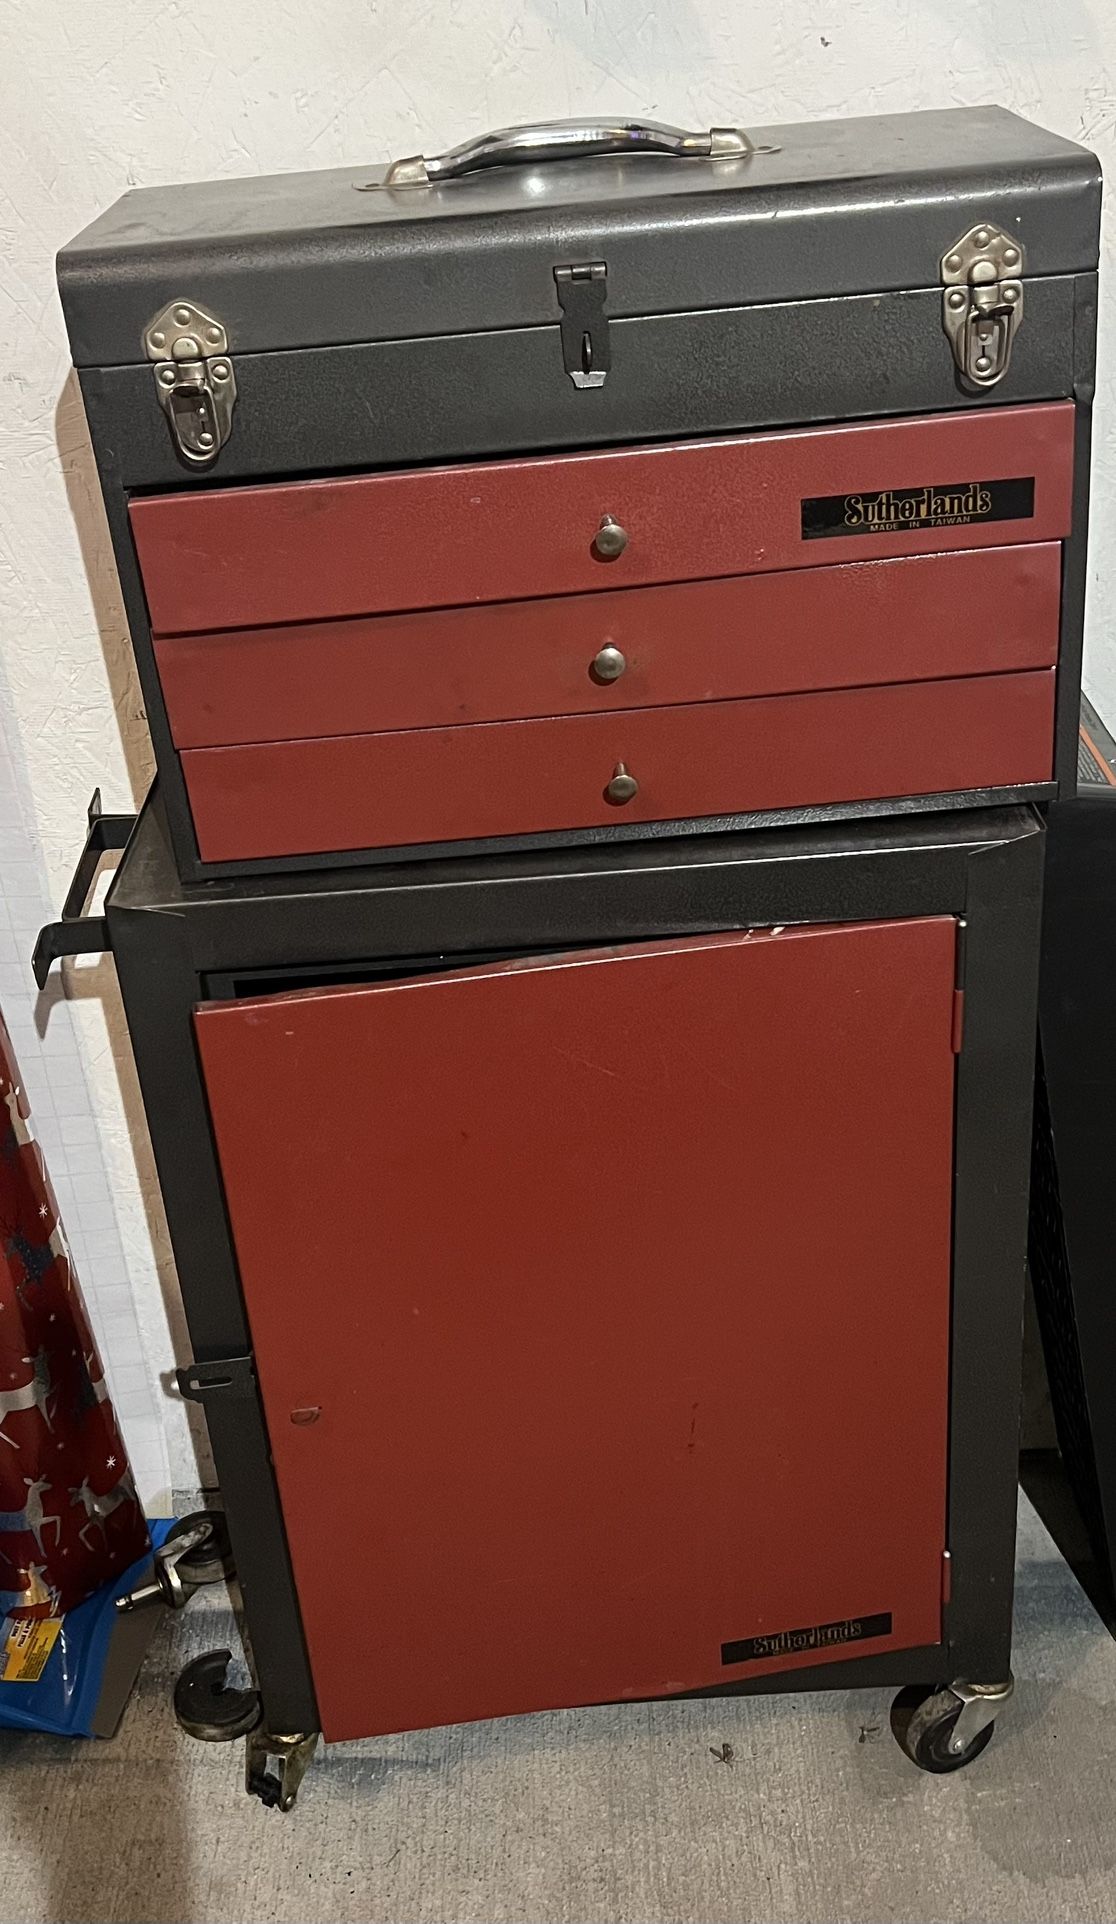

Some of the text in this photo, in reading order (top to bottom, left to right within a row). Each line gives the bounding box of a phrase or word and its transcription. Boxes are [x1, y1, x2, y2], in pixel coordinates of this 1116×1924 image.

[845, 484, 991, 526] Sutherlands
[870, 515, 971, 532] MADE IN TAIWAN
